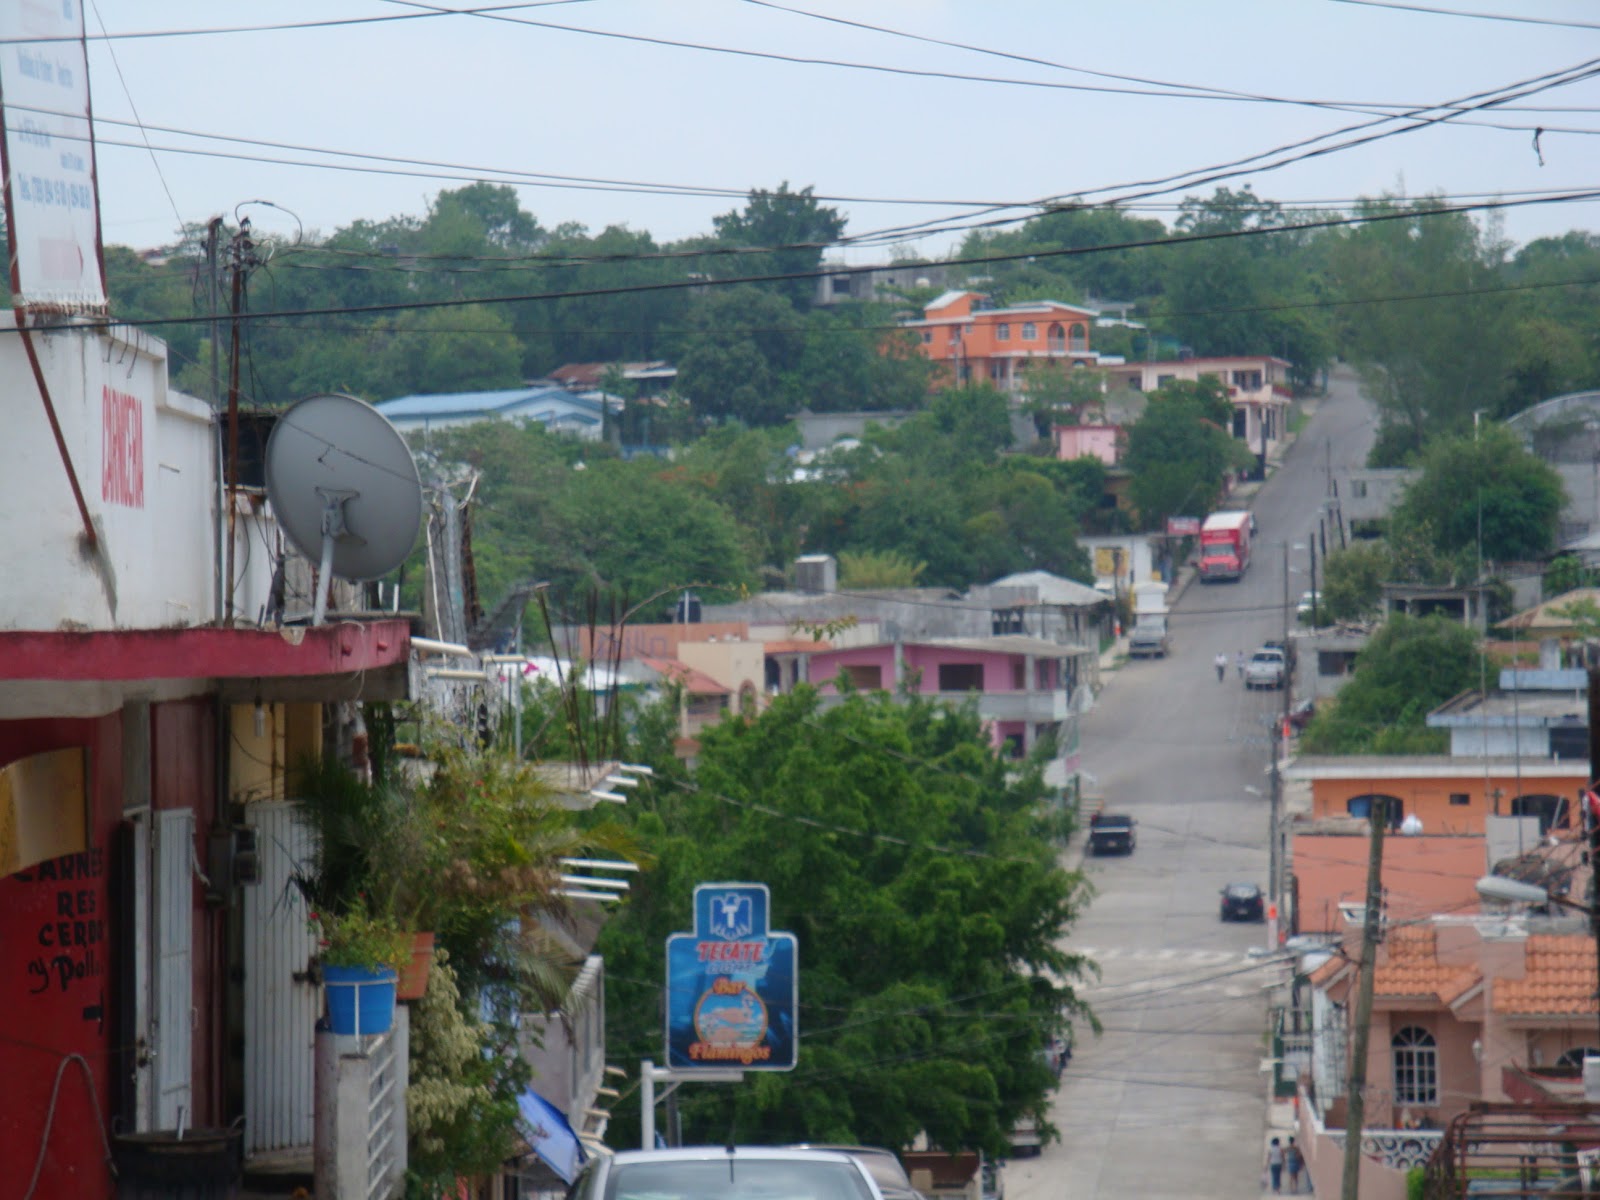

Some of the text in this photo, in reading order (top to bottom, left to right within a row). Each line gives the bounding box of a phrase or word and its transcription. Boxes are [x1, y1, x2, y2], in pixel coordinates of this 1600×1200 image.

[57, 890, 96, 918] RES
[697, 940, 767, 963] TECATE
[28, 957, 50, 994] y
[712, 977, 746, 996] Bar
[688, 1042, 772, 1066] Flamingos
